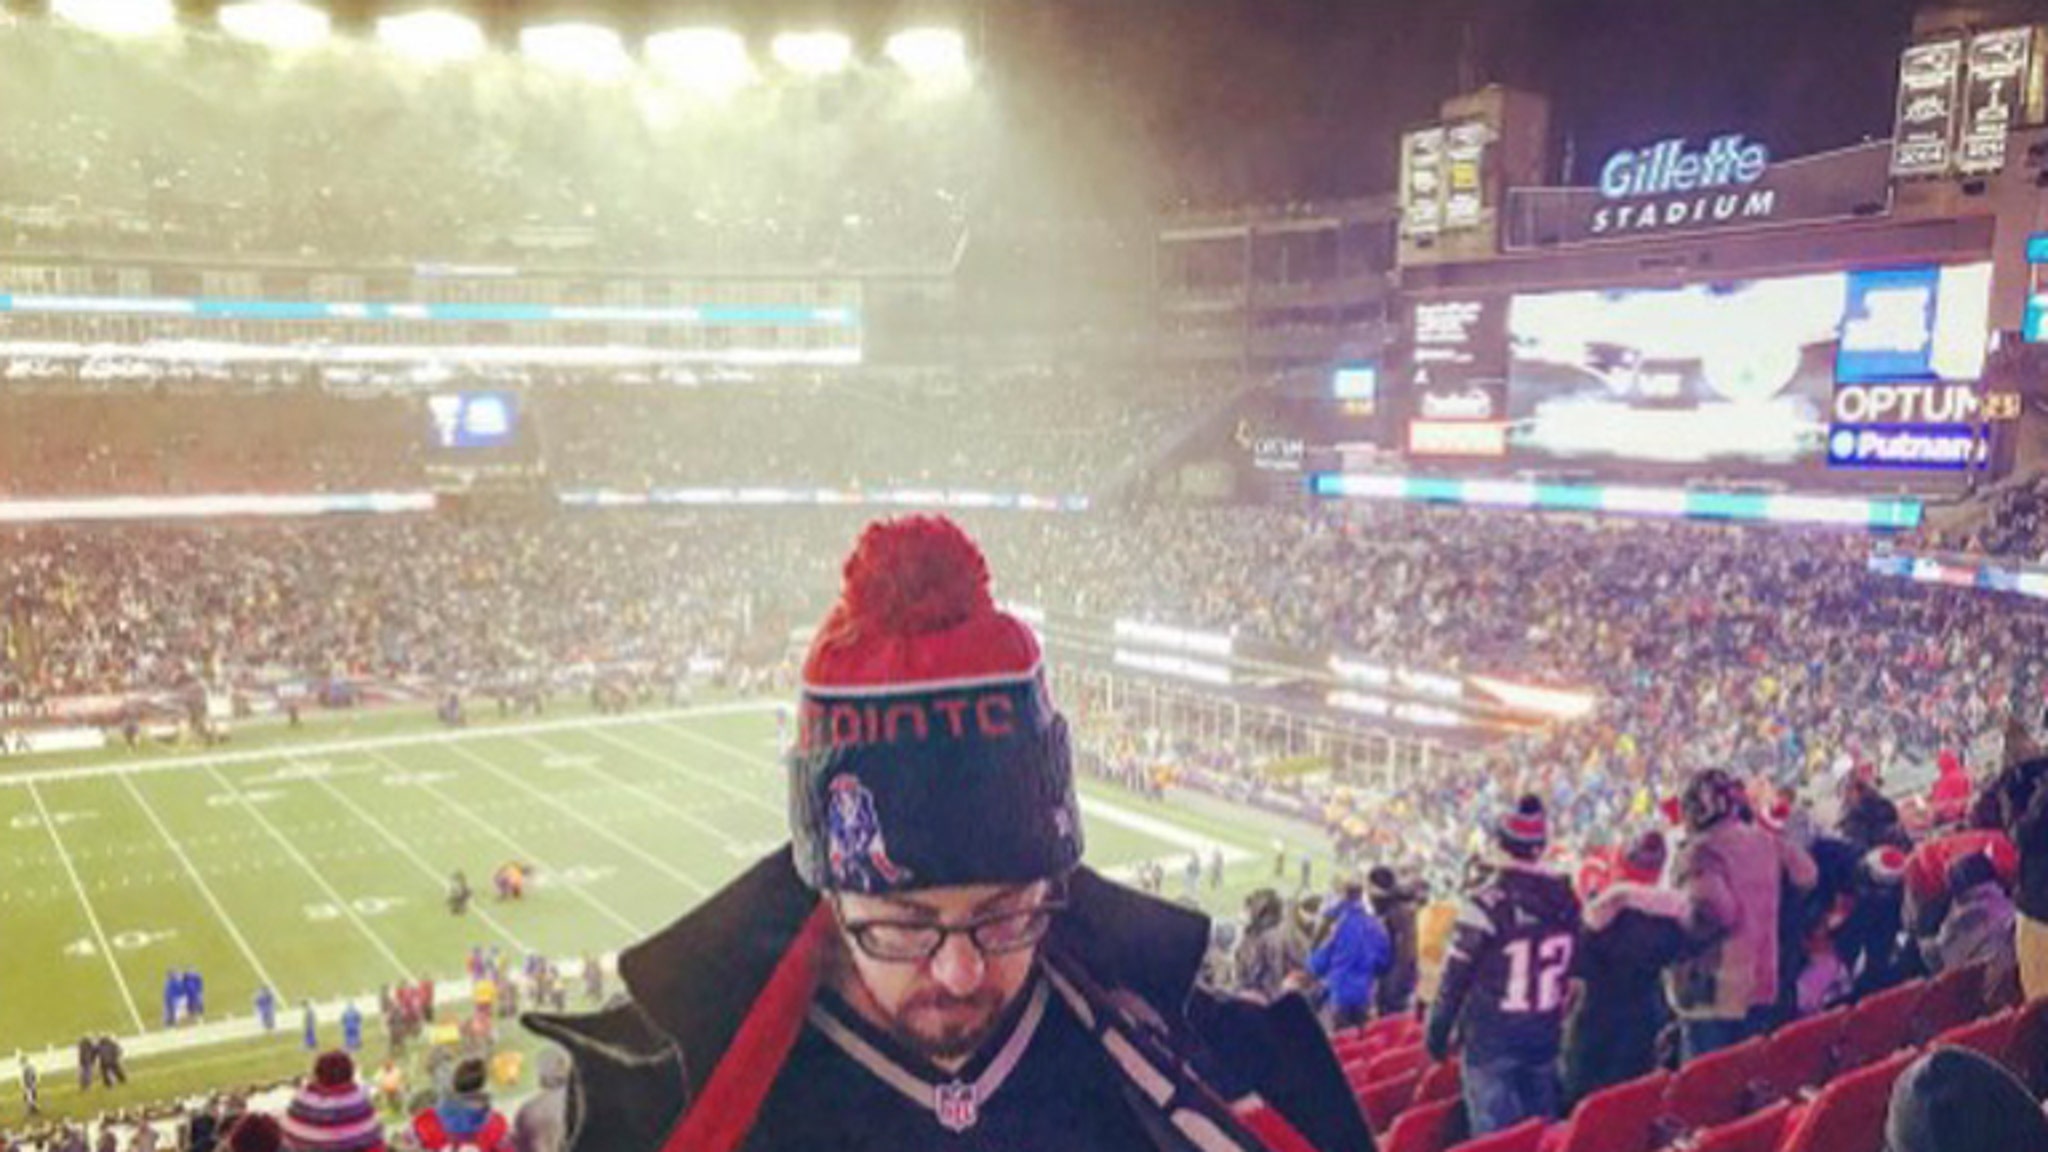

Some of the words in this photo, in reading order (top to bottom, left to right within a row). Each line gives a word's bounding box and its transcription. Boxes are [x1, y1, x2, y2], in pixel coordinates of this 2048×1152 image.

[1601, 133, 1767, 198] Gillette
[1591, 190, 1775, 233] STADIUM
[1857, 430, 1988, 462] Putnam
[1499, 933, 1573, 1012] 12
